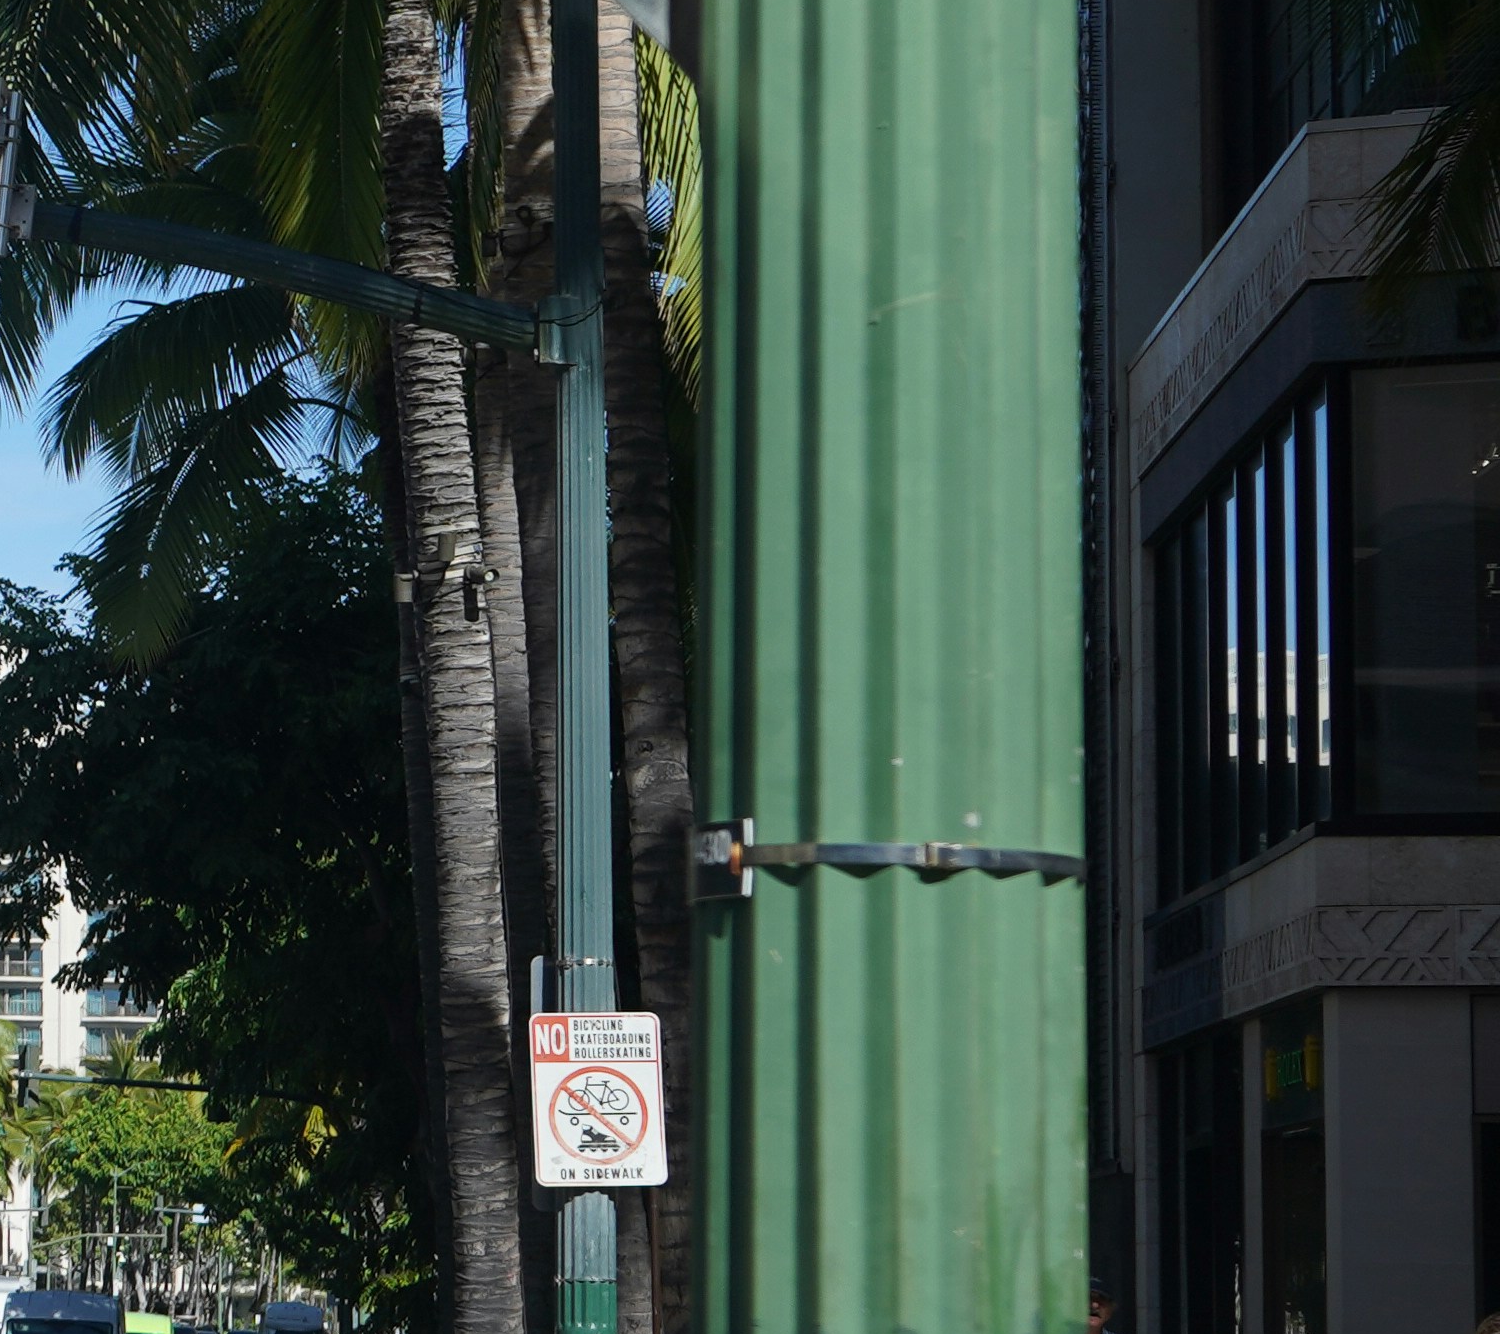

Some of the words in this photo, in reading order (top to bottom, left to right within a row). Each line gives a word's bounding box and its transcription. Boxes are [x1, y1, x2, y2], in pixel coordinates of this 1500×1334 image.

[534, 1023, 566, 1055] NO
[573, 1019, 623, 1031] BICYCLING
[574, 1033, 651, 1044] SKATEBOARDING
[575, 1047, 652, 1058] ROLLERSKATING
[560, 1169, 576, 1180] ON
[583, 1168, 644, 1180] SIDEWALK
